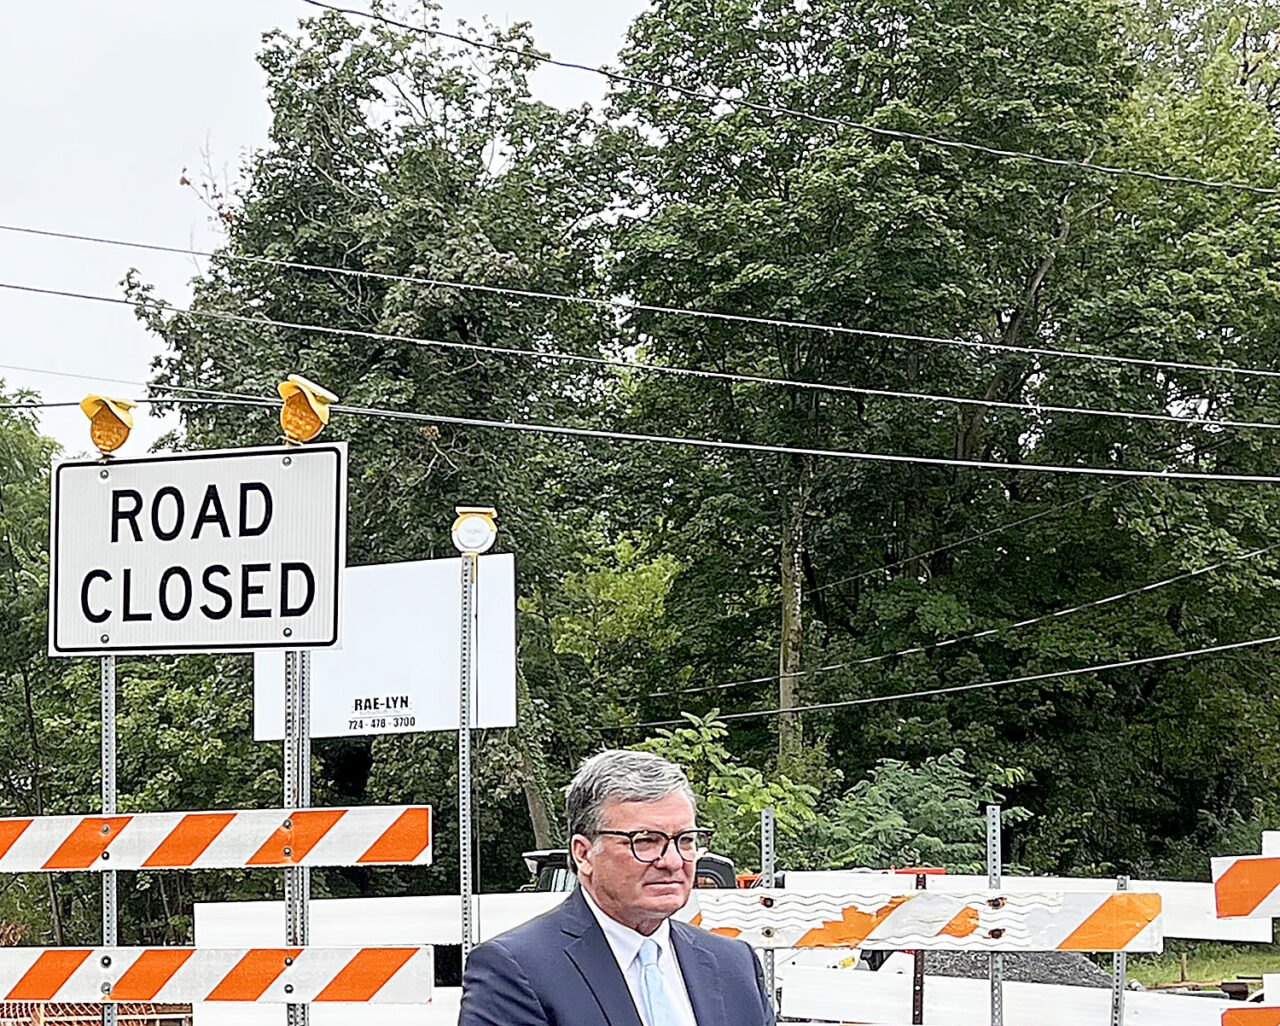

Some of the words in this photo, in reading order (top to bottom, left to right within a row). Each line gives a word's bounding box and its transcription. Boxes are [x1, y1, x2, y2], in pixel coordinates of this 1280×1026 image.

[110, 481, 273, 543] ROAD
[80, 561, 316, 624] CLOSED
[354, 695, 409, 712] RAE-LYN
